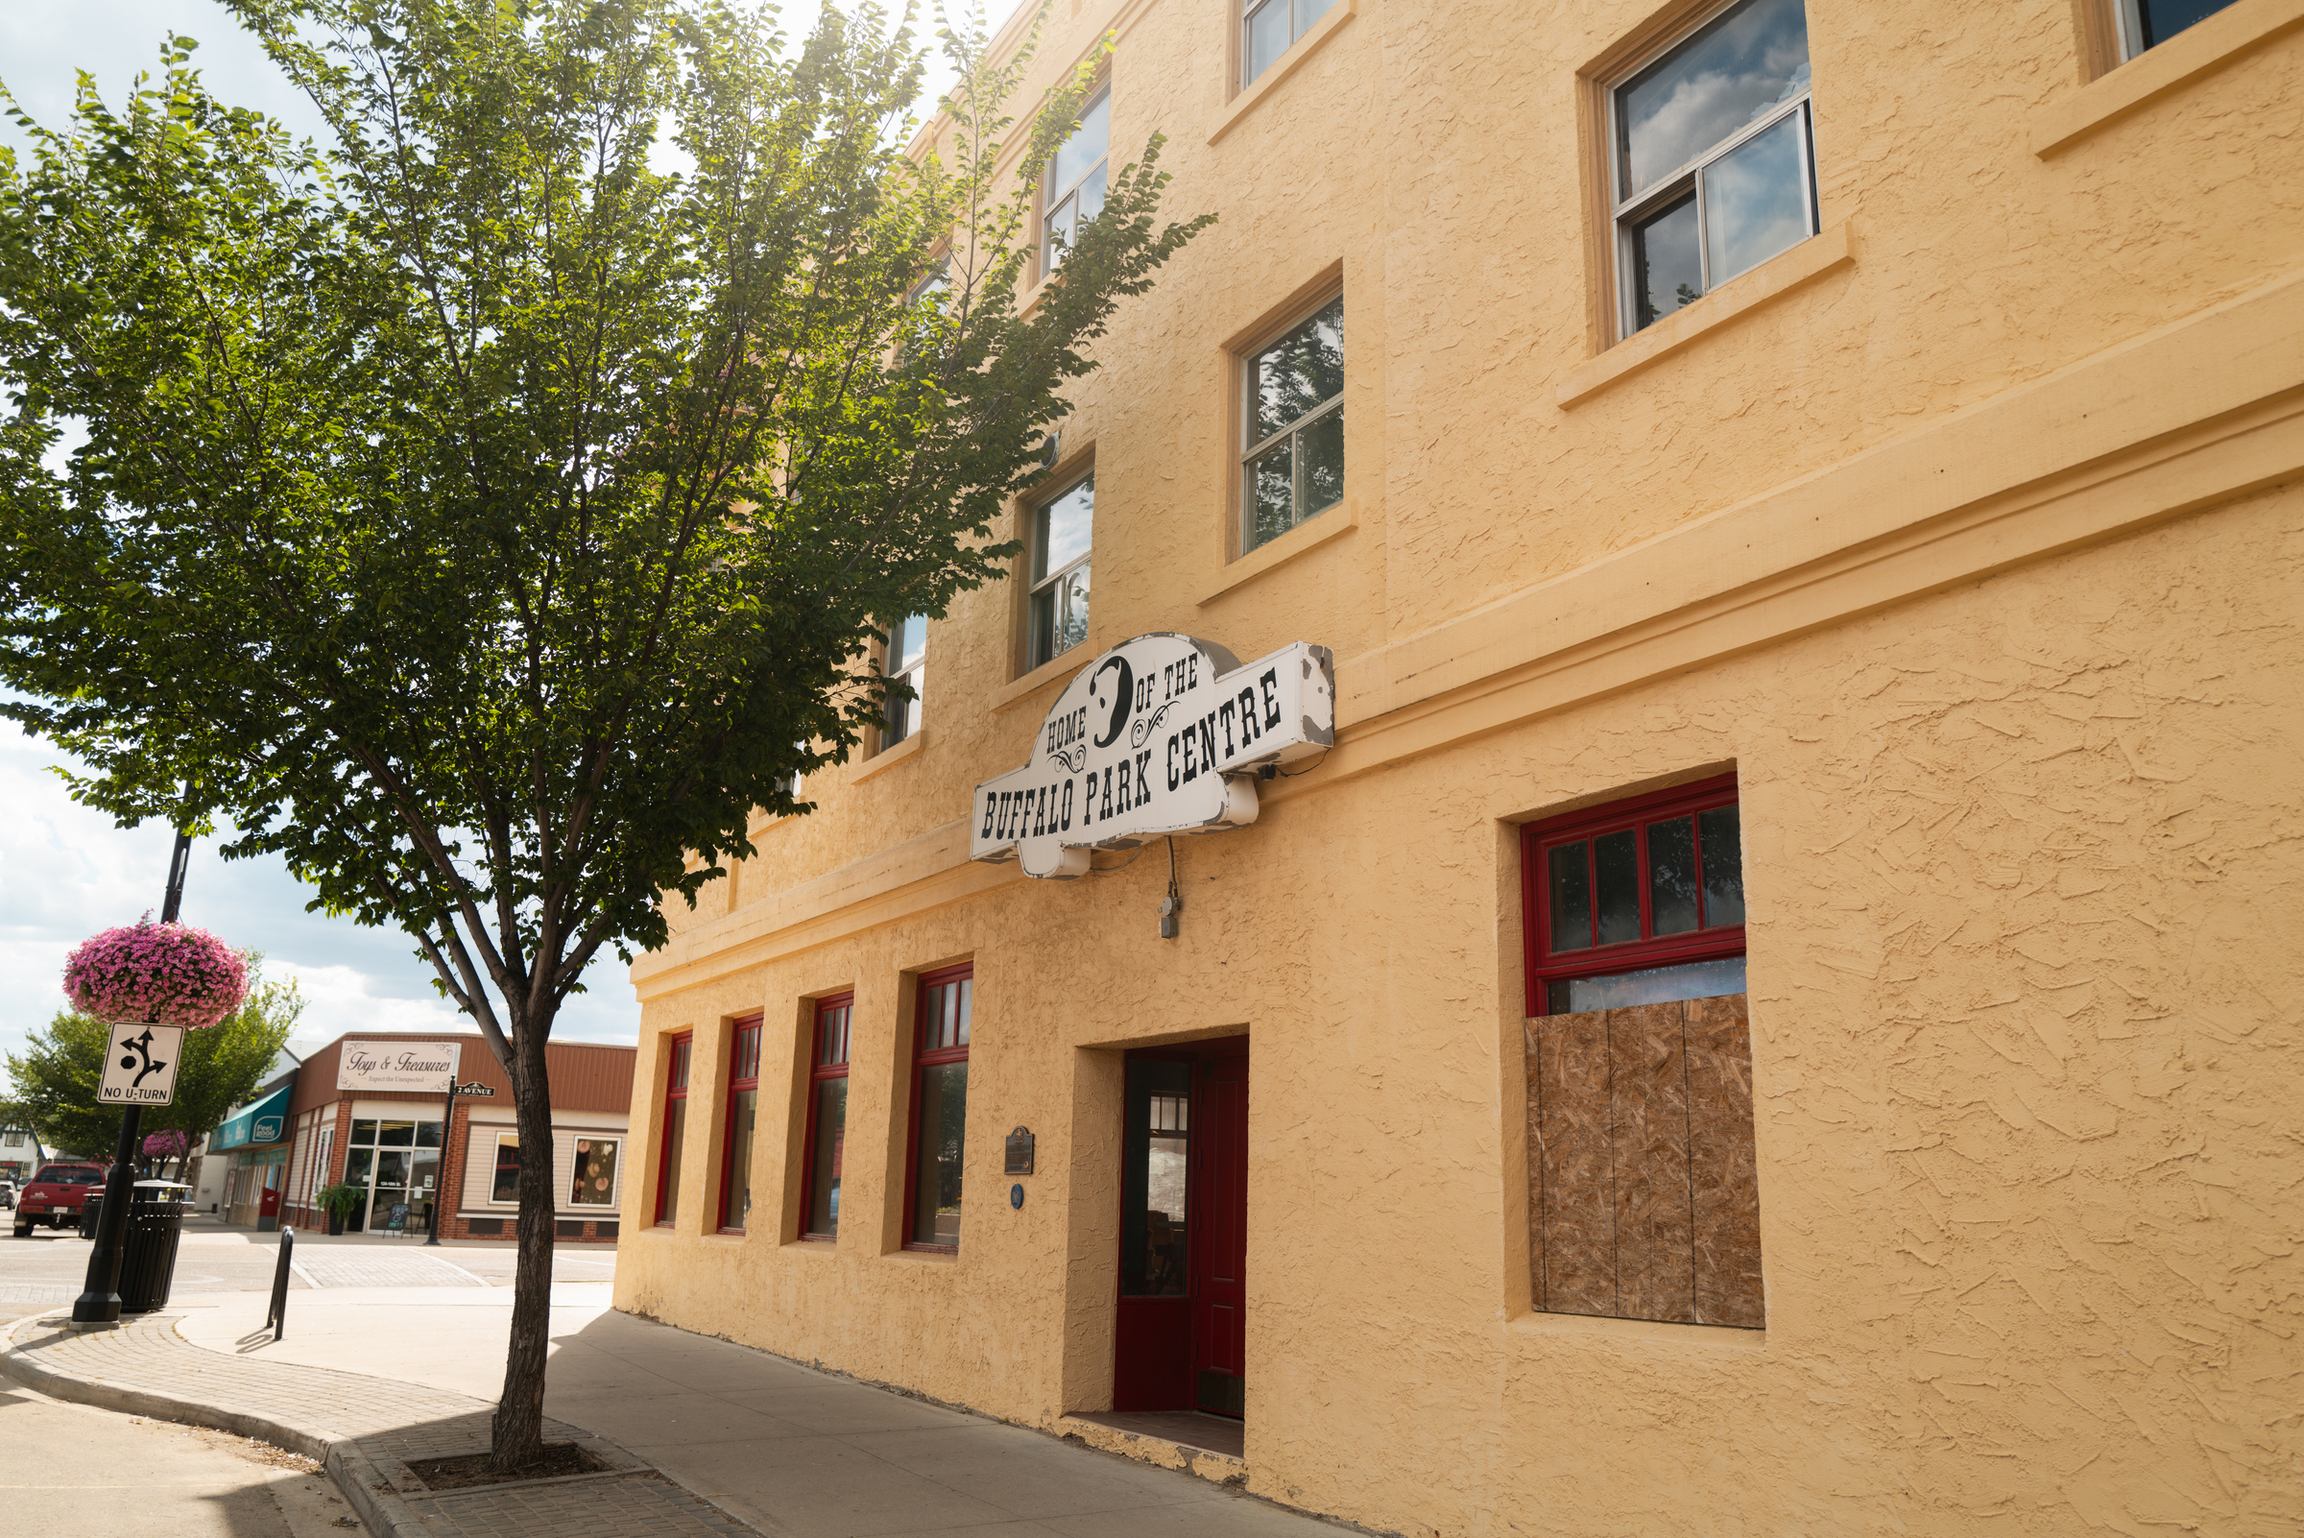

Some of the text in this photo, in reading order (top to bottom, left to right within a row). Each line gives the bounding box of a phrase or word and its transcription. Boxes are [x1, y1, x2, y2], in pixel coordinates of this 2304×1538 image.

[1047, 652, 1198, 754] HOME OF THE
[981, 666, 1281, 840] BUFFALO PARK CENTRE
[347, 1051, 450, 1076] Toys & Treasures
[104, 1087, 167, 1099] NO U-TURN
[463, 1087, 492, 1095] AVENUE
